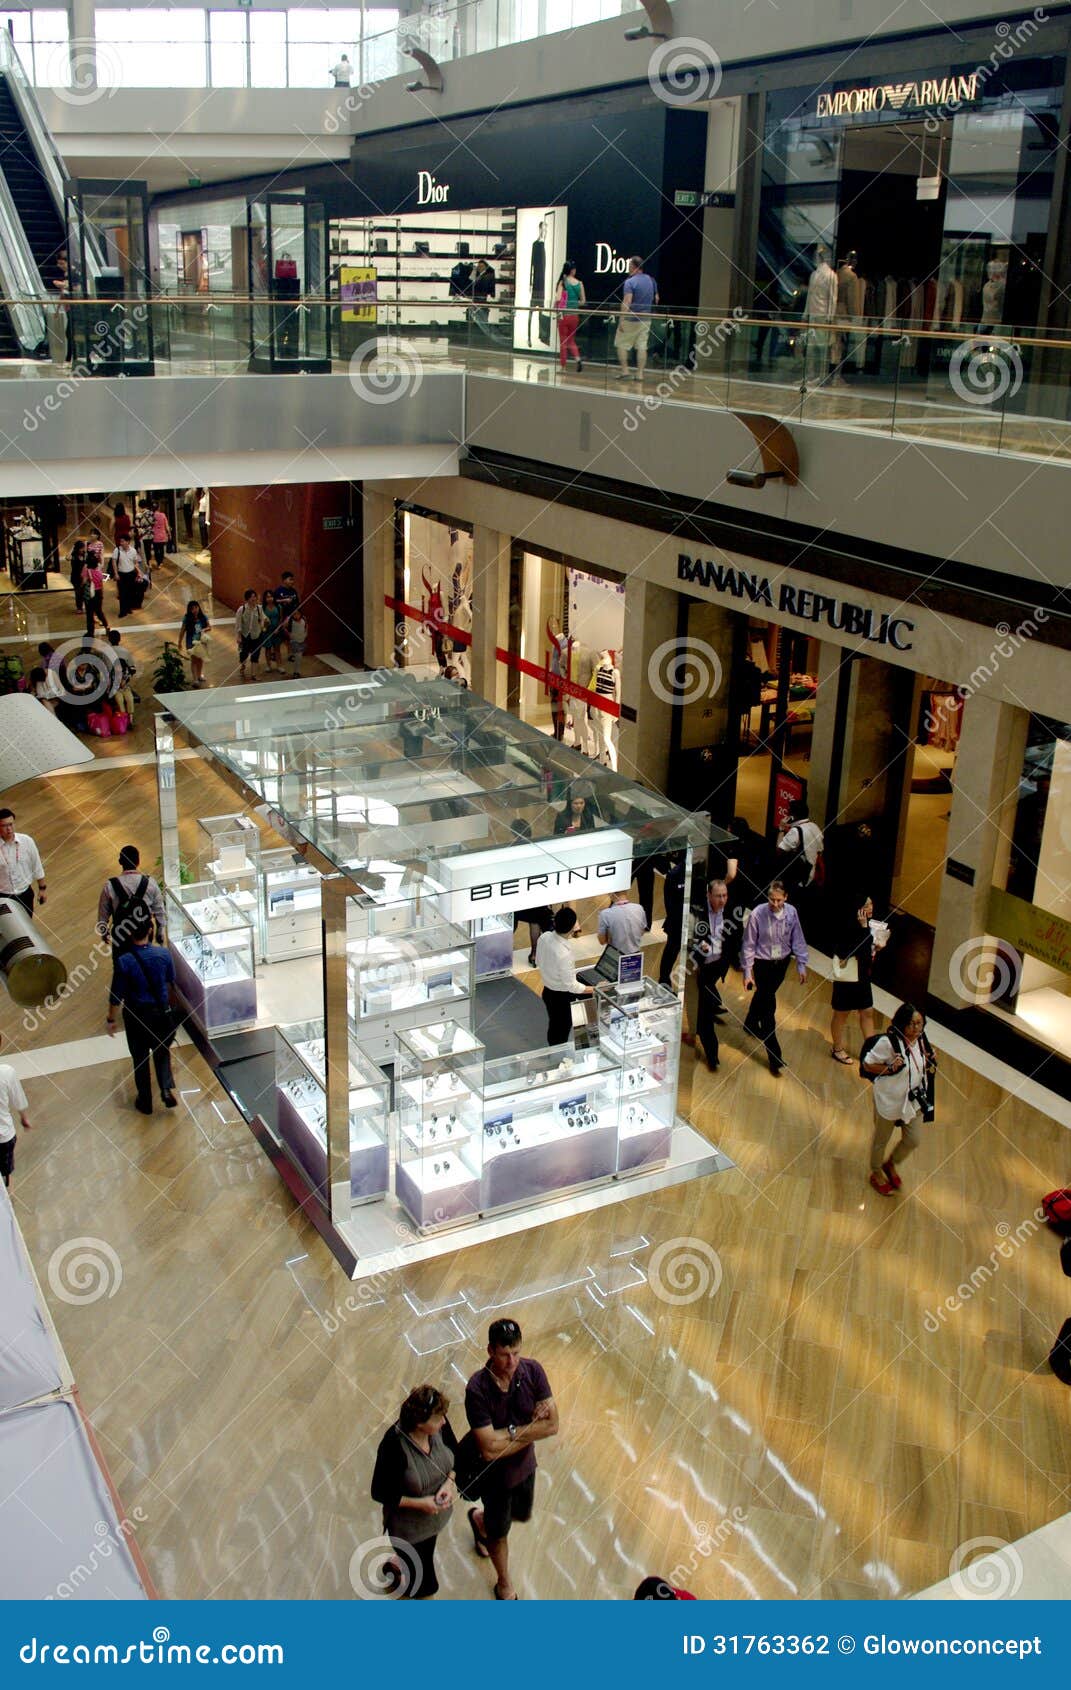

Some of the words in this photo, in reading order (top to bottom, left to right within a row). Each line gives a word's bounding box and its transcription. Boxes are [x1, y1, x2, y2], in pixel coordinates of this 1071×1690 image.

[816, 85, 886, 118] EMPORIO
[907, 74, 977, 107] ARMANI
[417, 171, 449, 204] Dior
[594, 243, 632, 273] Dior
[678, 554, 773, 607] BANANA
[779, 583, 914, 650] REPUBLIC
[471, 861, 616, 901] BERING
